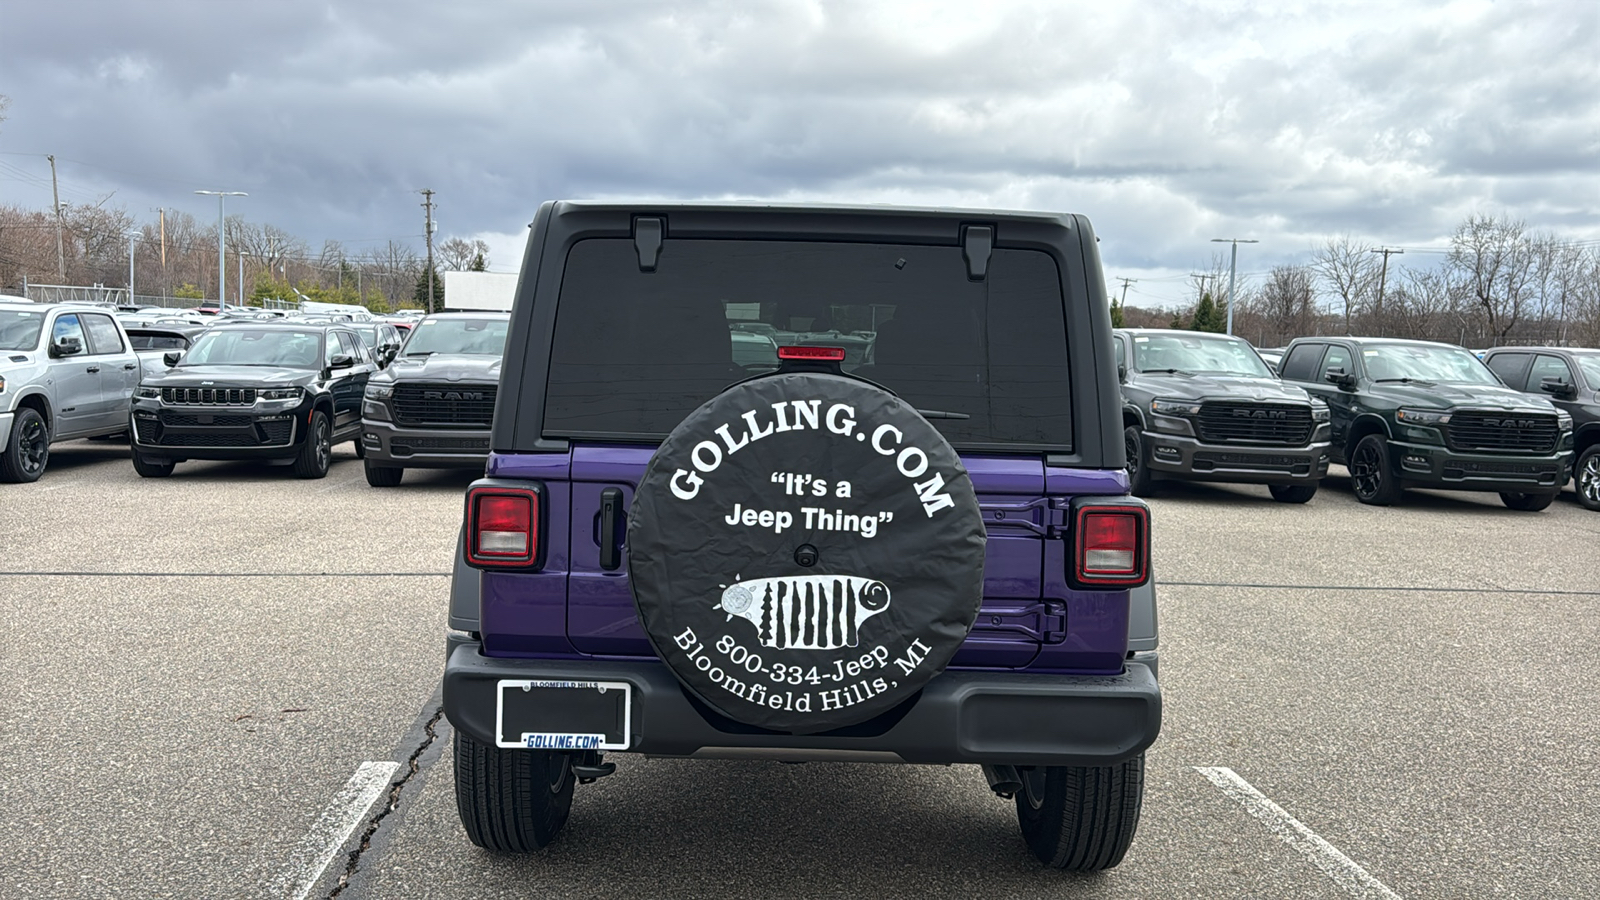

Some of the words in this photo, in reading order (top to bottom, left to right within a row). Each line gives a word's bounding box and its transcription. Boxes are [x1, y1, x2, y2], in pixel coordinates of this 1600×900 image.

[424, 391, 483, 400] RAM
[1232, 409, 1287, 419] RAM
[1482, 418, 1535, 428] RAM
[669, 399, 956, 518] GOLLING.COM
[835, 480, 852, 498] a
[724, 503, 793, 534] Jeep
[800, 507, 894, 538] Thing”
[715, 634, 889, 685] 800-334-Jeep
[673, 626, 812, 713] Bloomfield
[818, 675, 898, 712] Hills,
[893, 637, 932, 677] MI
[530, 681, 576, 689] BLOOMFIELD
[527, 735, 599, 749] GOLLING.COM
